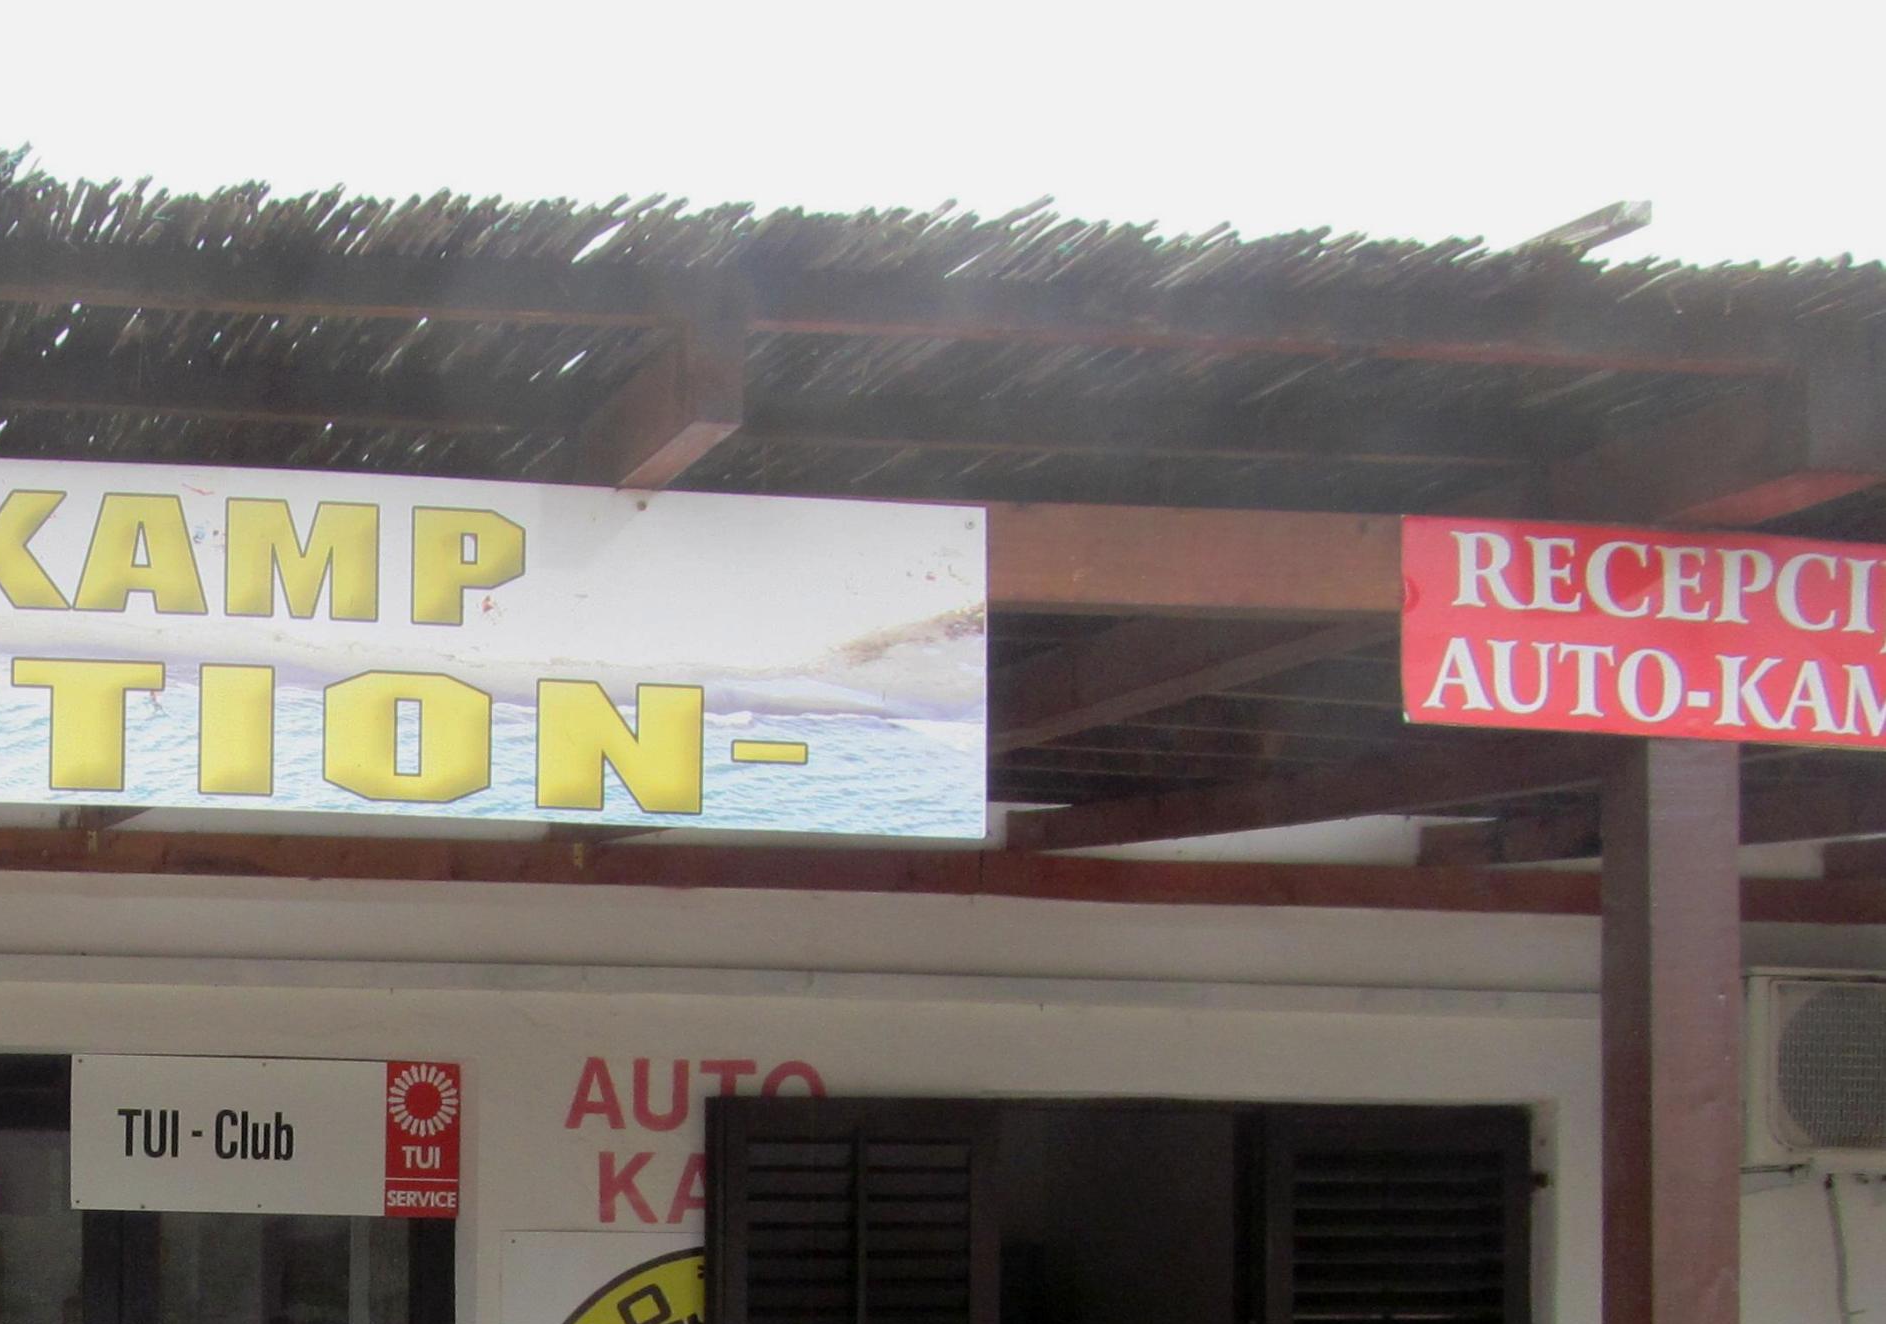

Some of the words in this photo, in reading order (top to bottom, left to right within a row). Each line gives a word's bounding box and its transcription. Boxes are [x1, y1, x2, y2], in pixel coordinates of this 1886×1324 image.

[1450, 531, 1886, 652] RECEPCI
[118, 1109, 179, 1158] TUI
[215, 1109, 294, 1161] Club
[401, 1145, 440, 1169] TUI
[386, 1189, 456, 1208] SERVICE
[599, 1151, 706, 1224] KA
